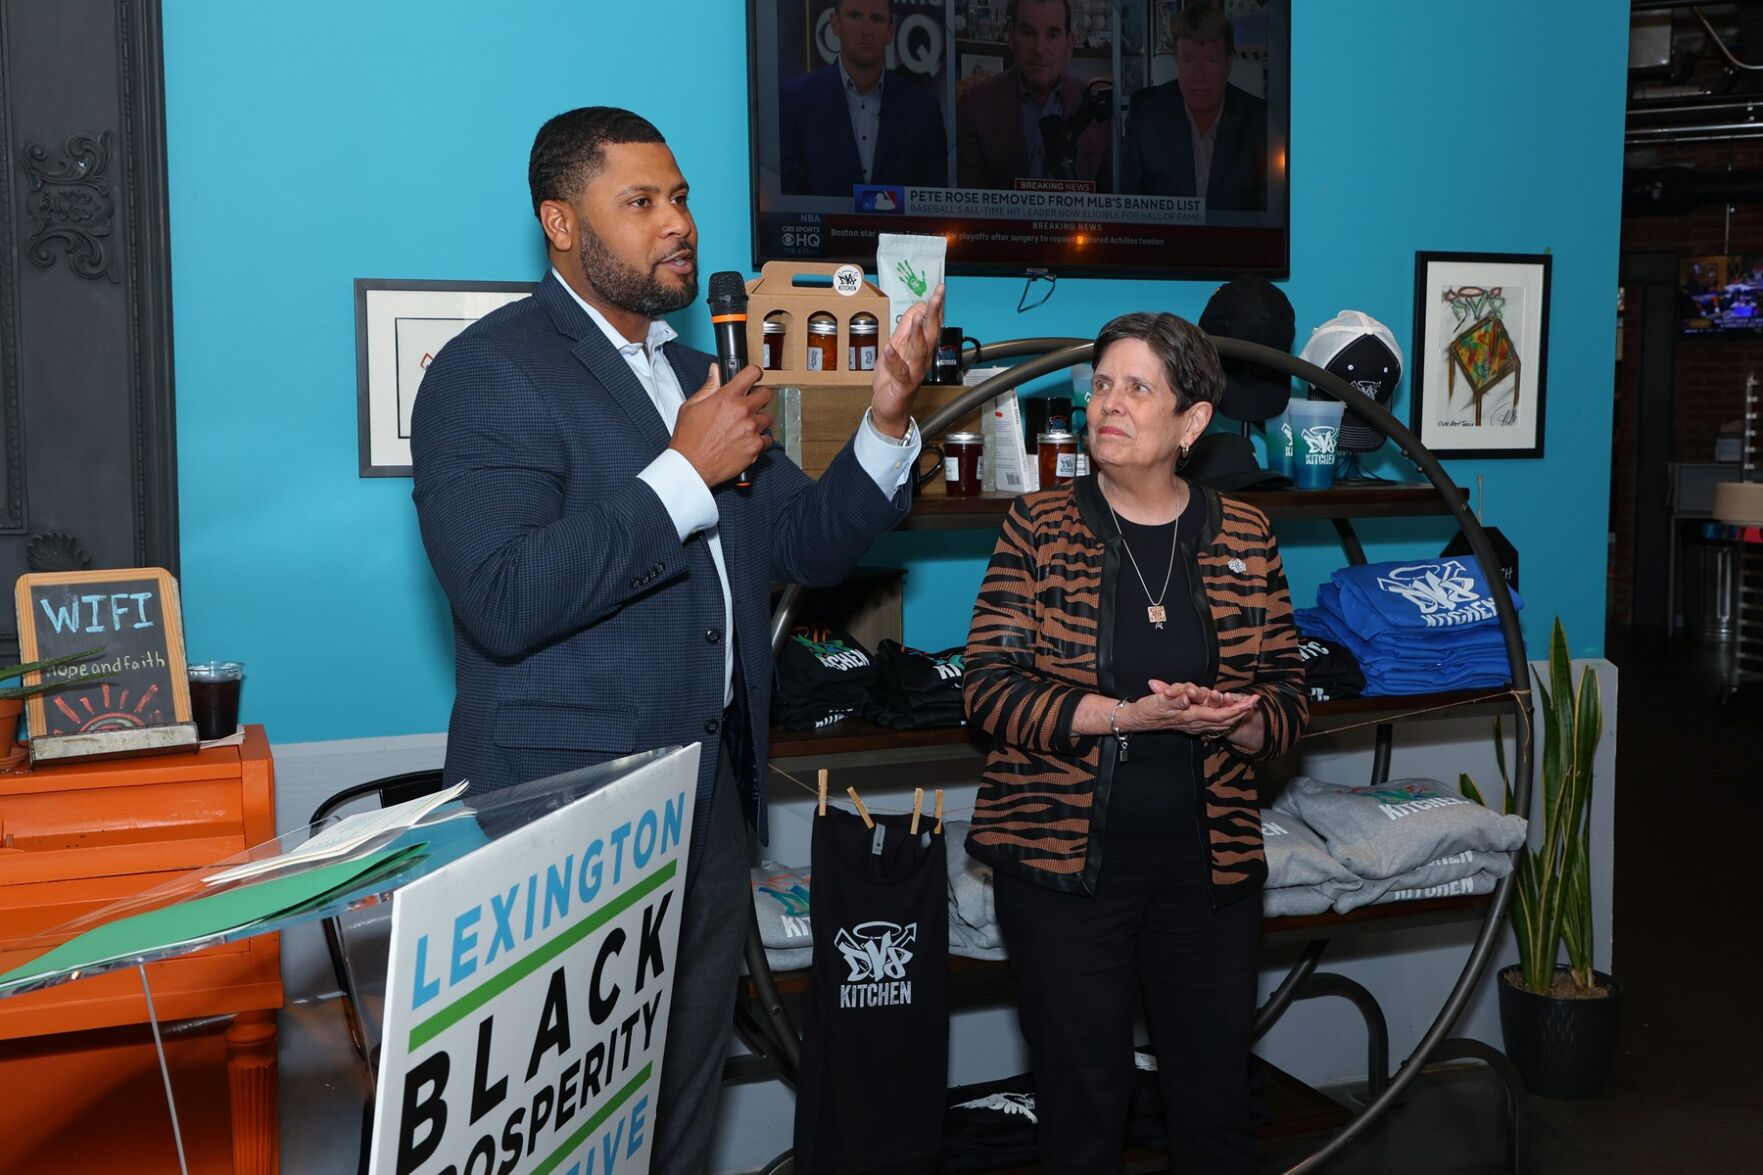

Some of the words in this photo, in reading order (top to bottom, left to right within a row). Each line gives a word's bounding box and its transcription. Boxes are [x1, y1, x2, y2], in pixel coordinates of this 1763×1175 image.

[1021, 181, 1064, 191] BREAKING
[1065, 183, 1090, 192] NEWS
[910, 191, 941, 202] PETE
[945, 192, 979, 204] ROSE
[983, 193, 1045, 206] REMOVED
[1049, 195, 1084, 207] FROM
[1088, 197, 1122, 209] MLB'S
[1125, 198, 1174, 210] BANNED
[1177, 200, 1200, 211] LIST
[800, 214, 821, 223] NBA
[910, 204, 963, 214] BASEBALL'S
[964, 206, 1006, 216] ALL-TIME
[1007, 207, 1022, 216] HIT
[1023, 208, 1057, 217] LEADER
[1058, 209, 1080, 218] NOW
[1082, 210, 1120, 219] ELIGIBLE
[1122, 210, 1140, 219] FOR
[1140, 211, 1162, 220] HALL
[1164, 212, 1177, 221] OF
[1177, 213, 1200, 222] FAME
[1032, 221, 1076, 231] BREAKING
[1078, 222, 1103, 232] NEWS
[796, 233, 821, 248] HQ
[831, 228, 859, 237] Boston
[860, 229, 875, 237] star
[959, 232, 989, 243] playoffs
[990, 232, 1009, 241] after
[1011, 234, 1039, 244] surgery
[1040, 234, 1048, 242] to
[1110, 236, 1137, 245] Achilles
[1139, 237, 1165, 246] tendon
[40, 592, 155, 635] WIFI
[411, 791, 686, 1011] LEXINGTON
[840, 981, 912, 1008] KITCHEN
[396, 889, 674, 1175] BLACK
[435, 988, 662, 1175] OSPERITY
